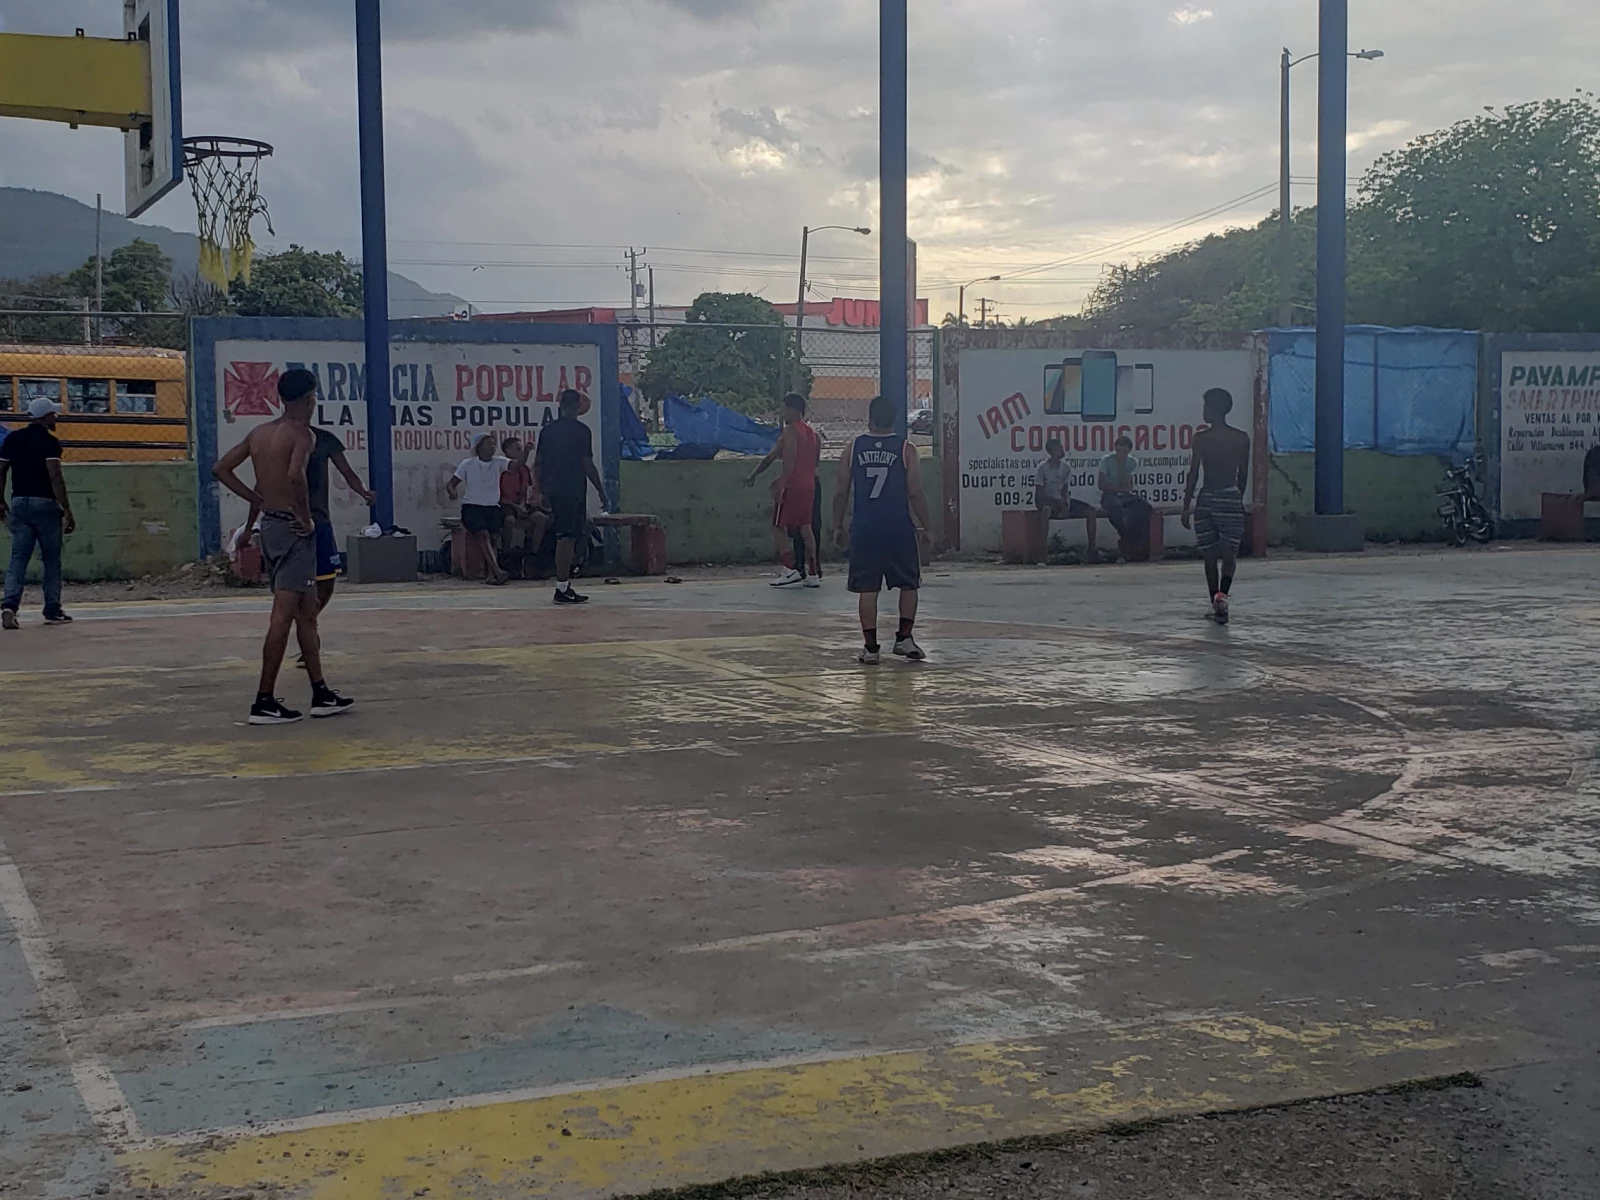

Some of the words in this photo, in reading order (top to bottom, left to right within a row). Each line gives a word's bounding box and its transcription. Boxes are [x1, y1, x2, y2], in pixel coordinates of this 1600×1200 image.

[285, 362, 440, 401] ARMCIA
[455, 364, 593, 403] POPULAR
[317, 404, 355, 426] LA
[976, 391, 1032, 440] IAM
[1524, 412, 1556, 424] VENTAS
[1560, 412, 1571, 424] AL
[1575, 412, 1592, 424] POR
[346, 429, 367, 451] DE
[394, 429, 472, 451] RODUCTOS
[1010, 424, 1209, 452] COMUNIACIO
[857, 450, 898, 466] ANTHONY
[968, 457, 1019, 470] specialistas
[866, 467, 889, 499] 7
[962, 473, 1016, 488] Duarte
[994, 491, 1035, 506] 809.2
